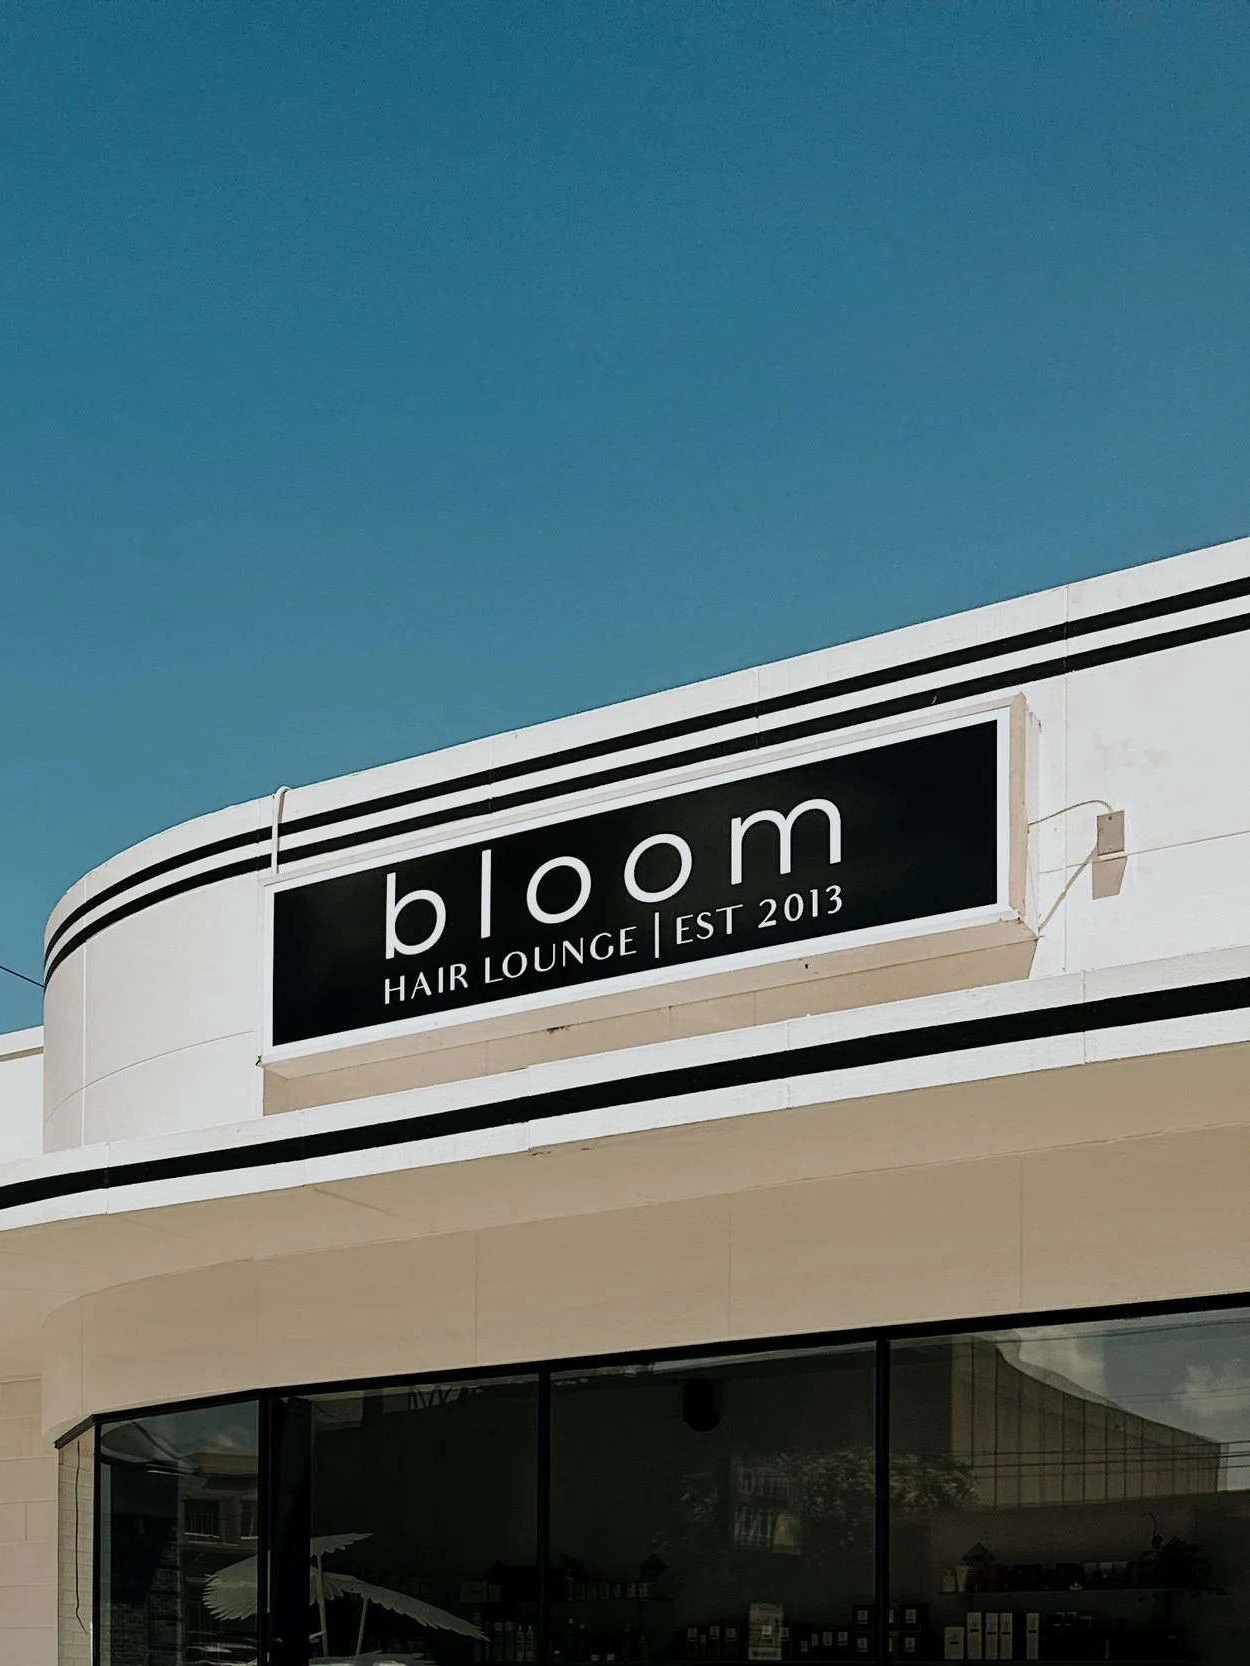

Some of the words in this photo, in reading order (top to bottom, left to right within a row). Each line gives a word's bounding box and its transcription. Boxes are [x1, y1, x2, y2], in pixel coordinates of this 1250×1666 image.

[384, 798, 842, 960] bloom
[384, 963, 469, 1005] HAIR
[484, 926, 637, 984] LOUNGE
[676, 904, 744, 945] EST
[757, 884, 843, 929] 2013
